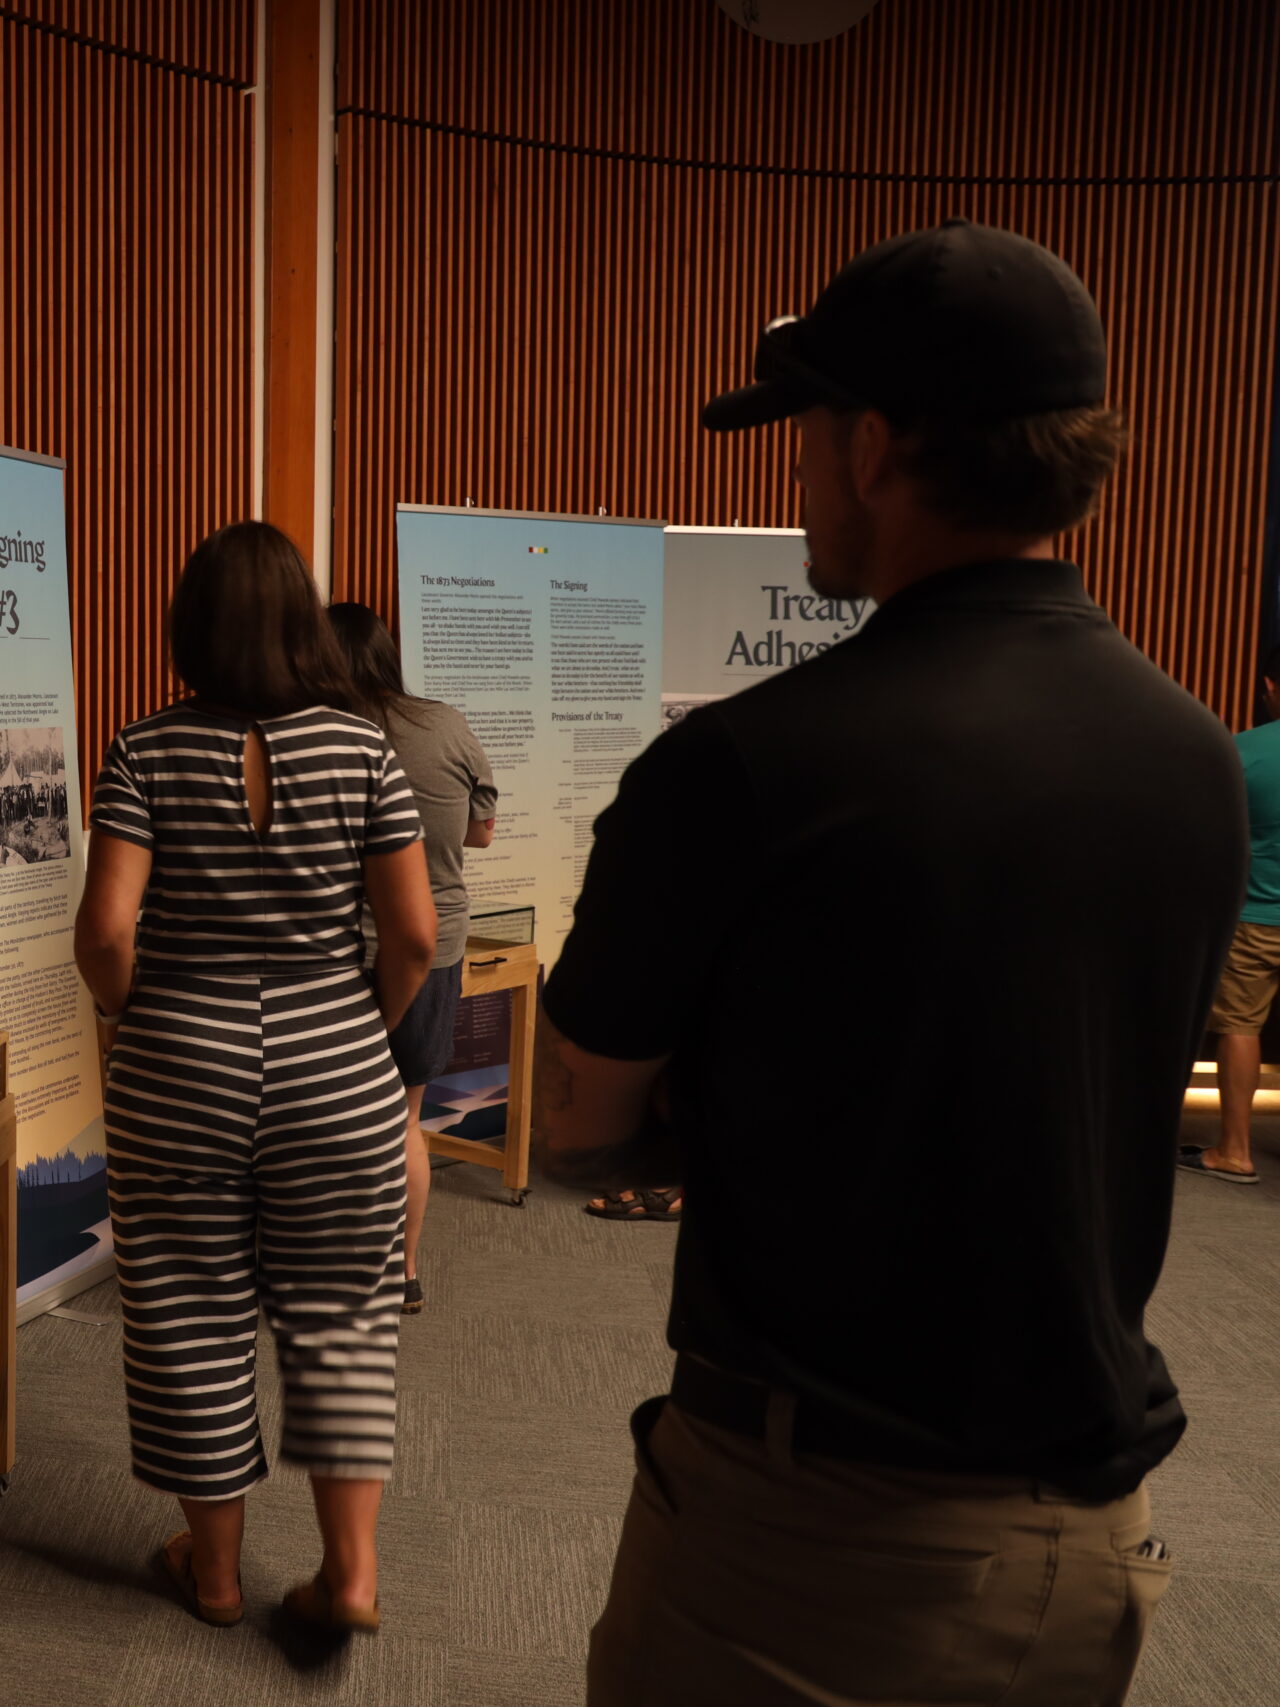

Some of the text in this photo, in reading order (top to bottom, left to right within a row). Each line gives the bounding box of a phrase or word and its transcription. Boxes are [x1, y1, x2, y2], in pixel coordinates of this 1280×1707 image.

[420, 575, 495, 588] The 1873 Negotiations
[550, 580, 587, 591] The Signing
[761, 585, 867, 630] Treaty
[726, 630, 840, 666] Adhe
[552, 712, 623, 721] Provisions of the Treaty
